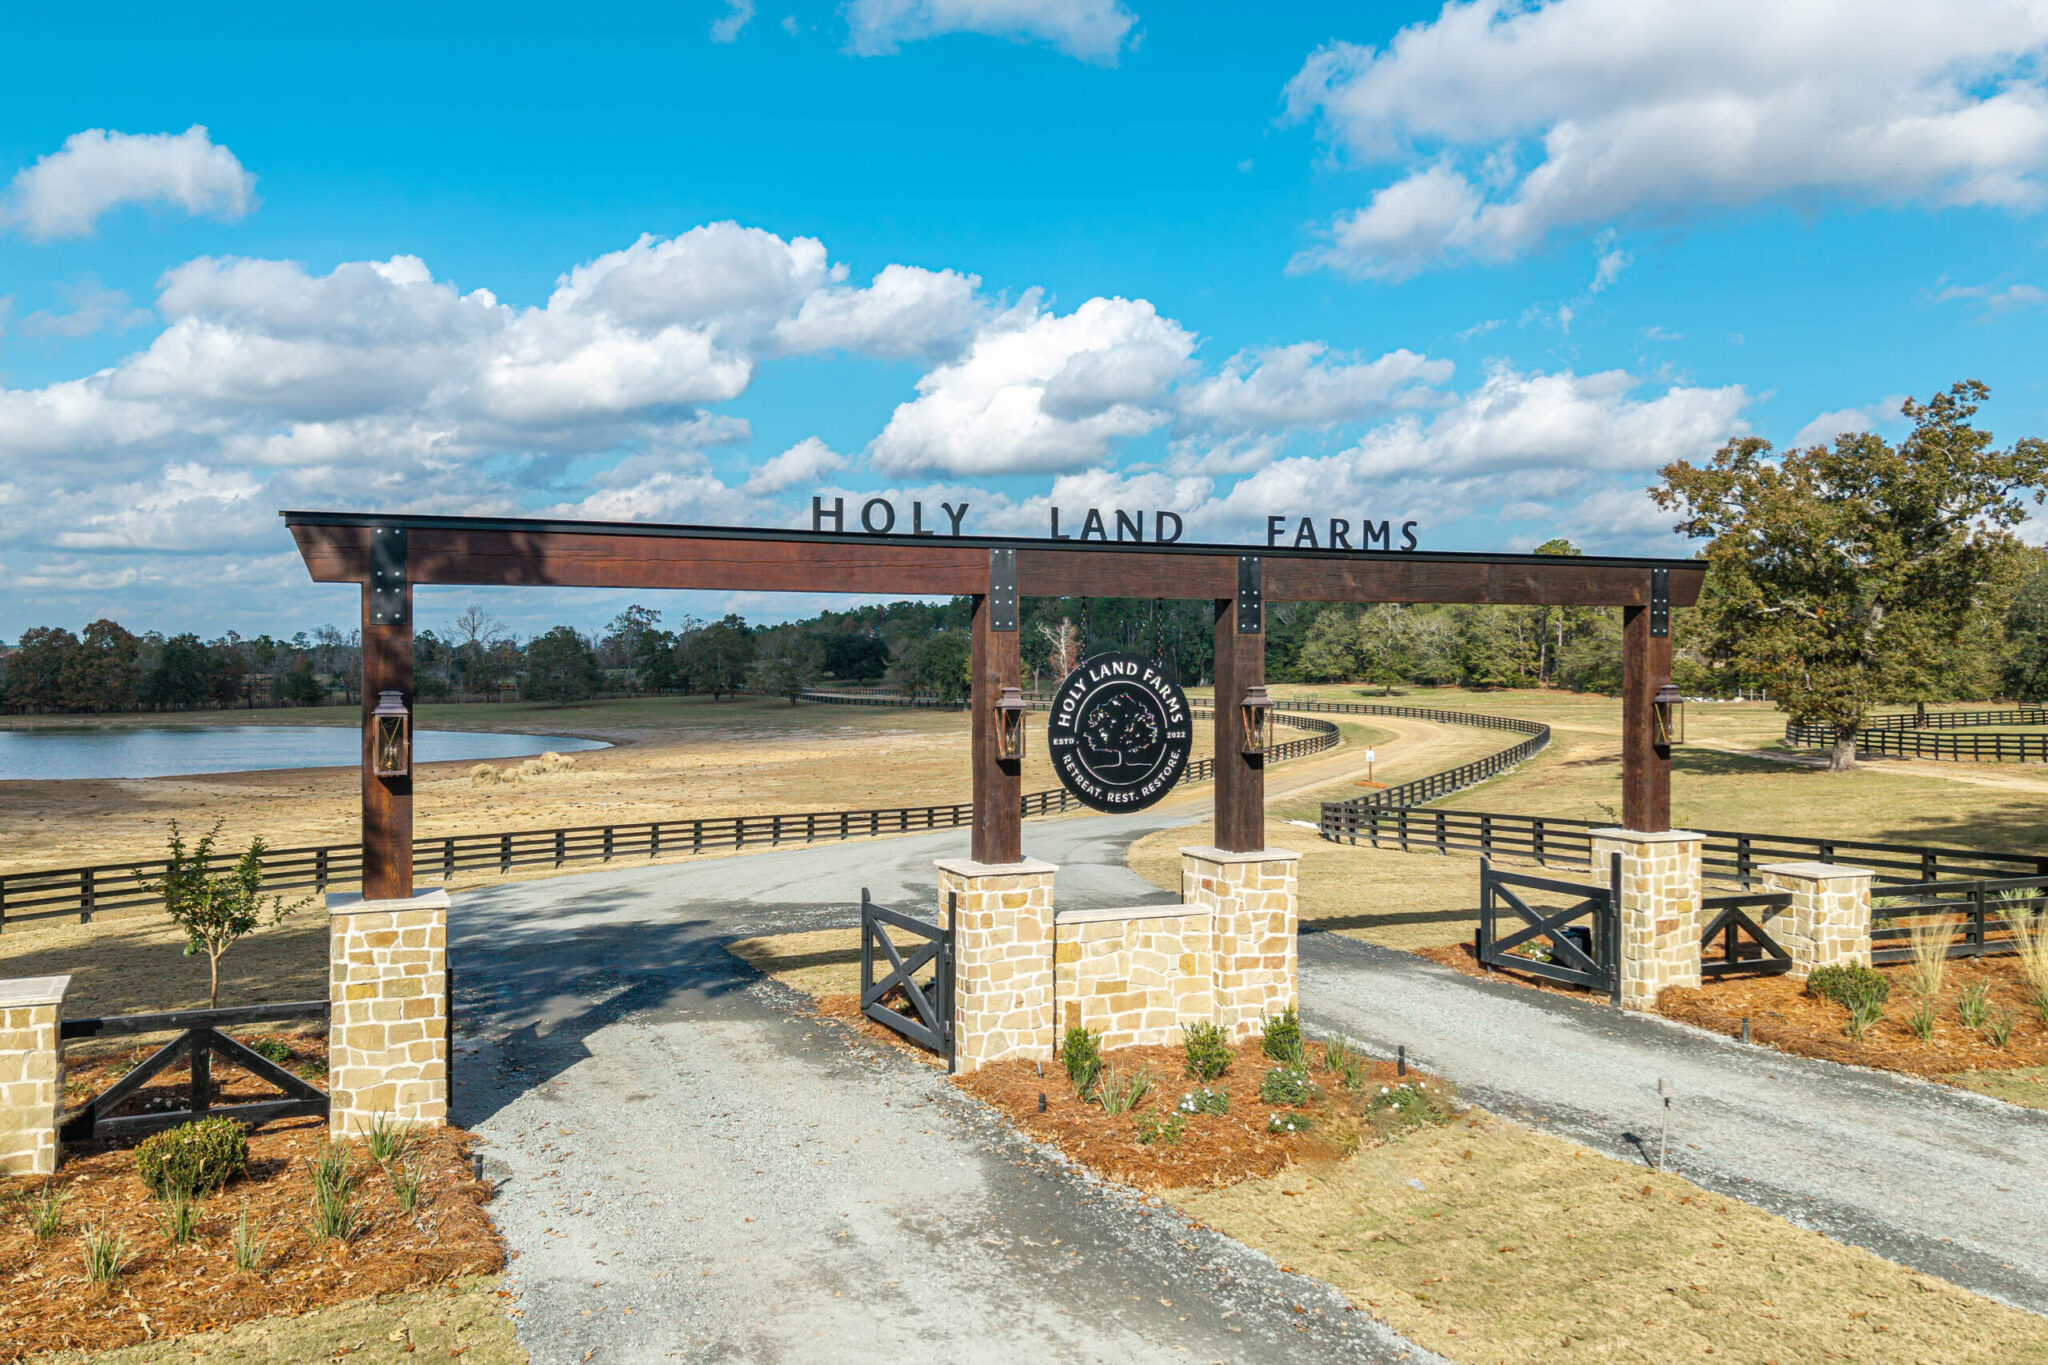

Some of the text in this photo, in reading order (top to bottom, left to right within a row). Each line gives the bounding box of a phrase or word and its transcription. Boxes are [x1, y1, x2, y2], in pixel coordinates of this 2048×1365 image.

[812, 496, 1417, 551] HOLY LAND FARMS
[1058, 661, 1183, 727] HOLY LAND FARMS
[1167, 731, 1186, 739] 2022
[1062, 749, 1181, 803] RETREAT. REST. RESTORE.
